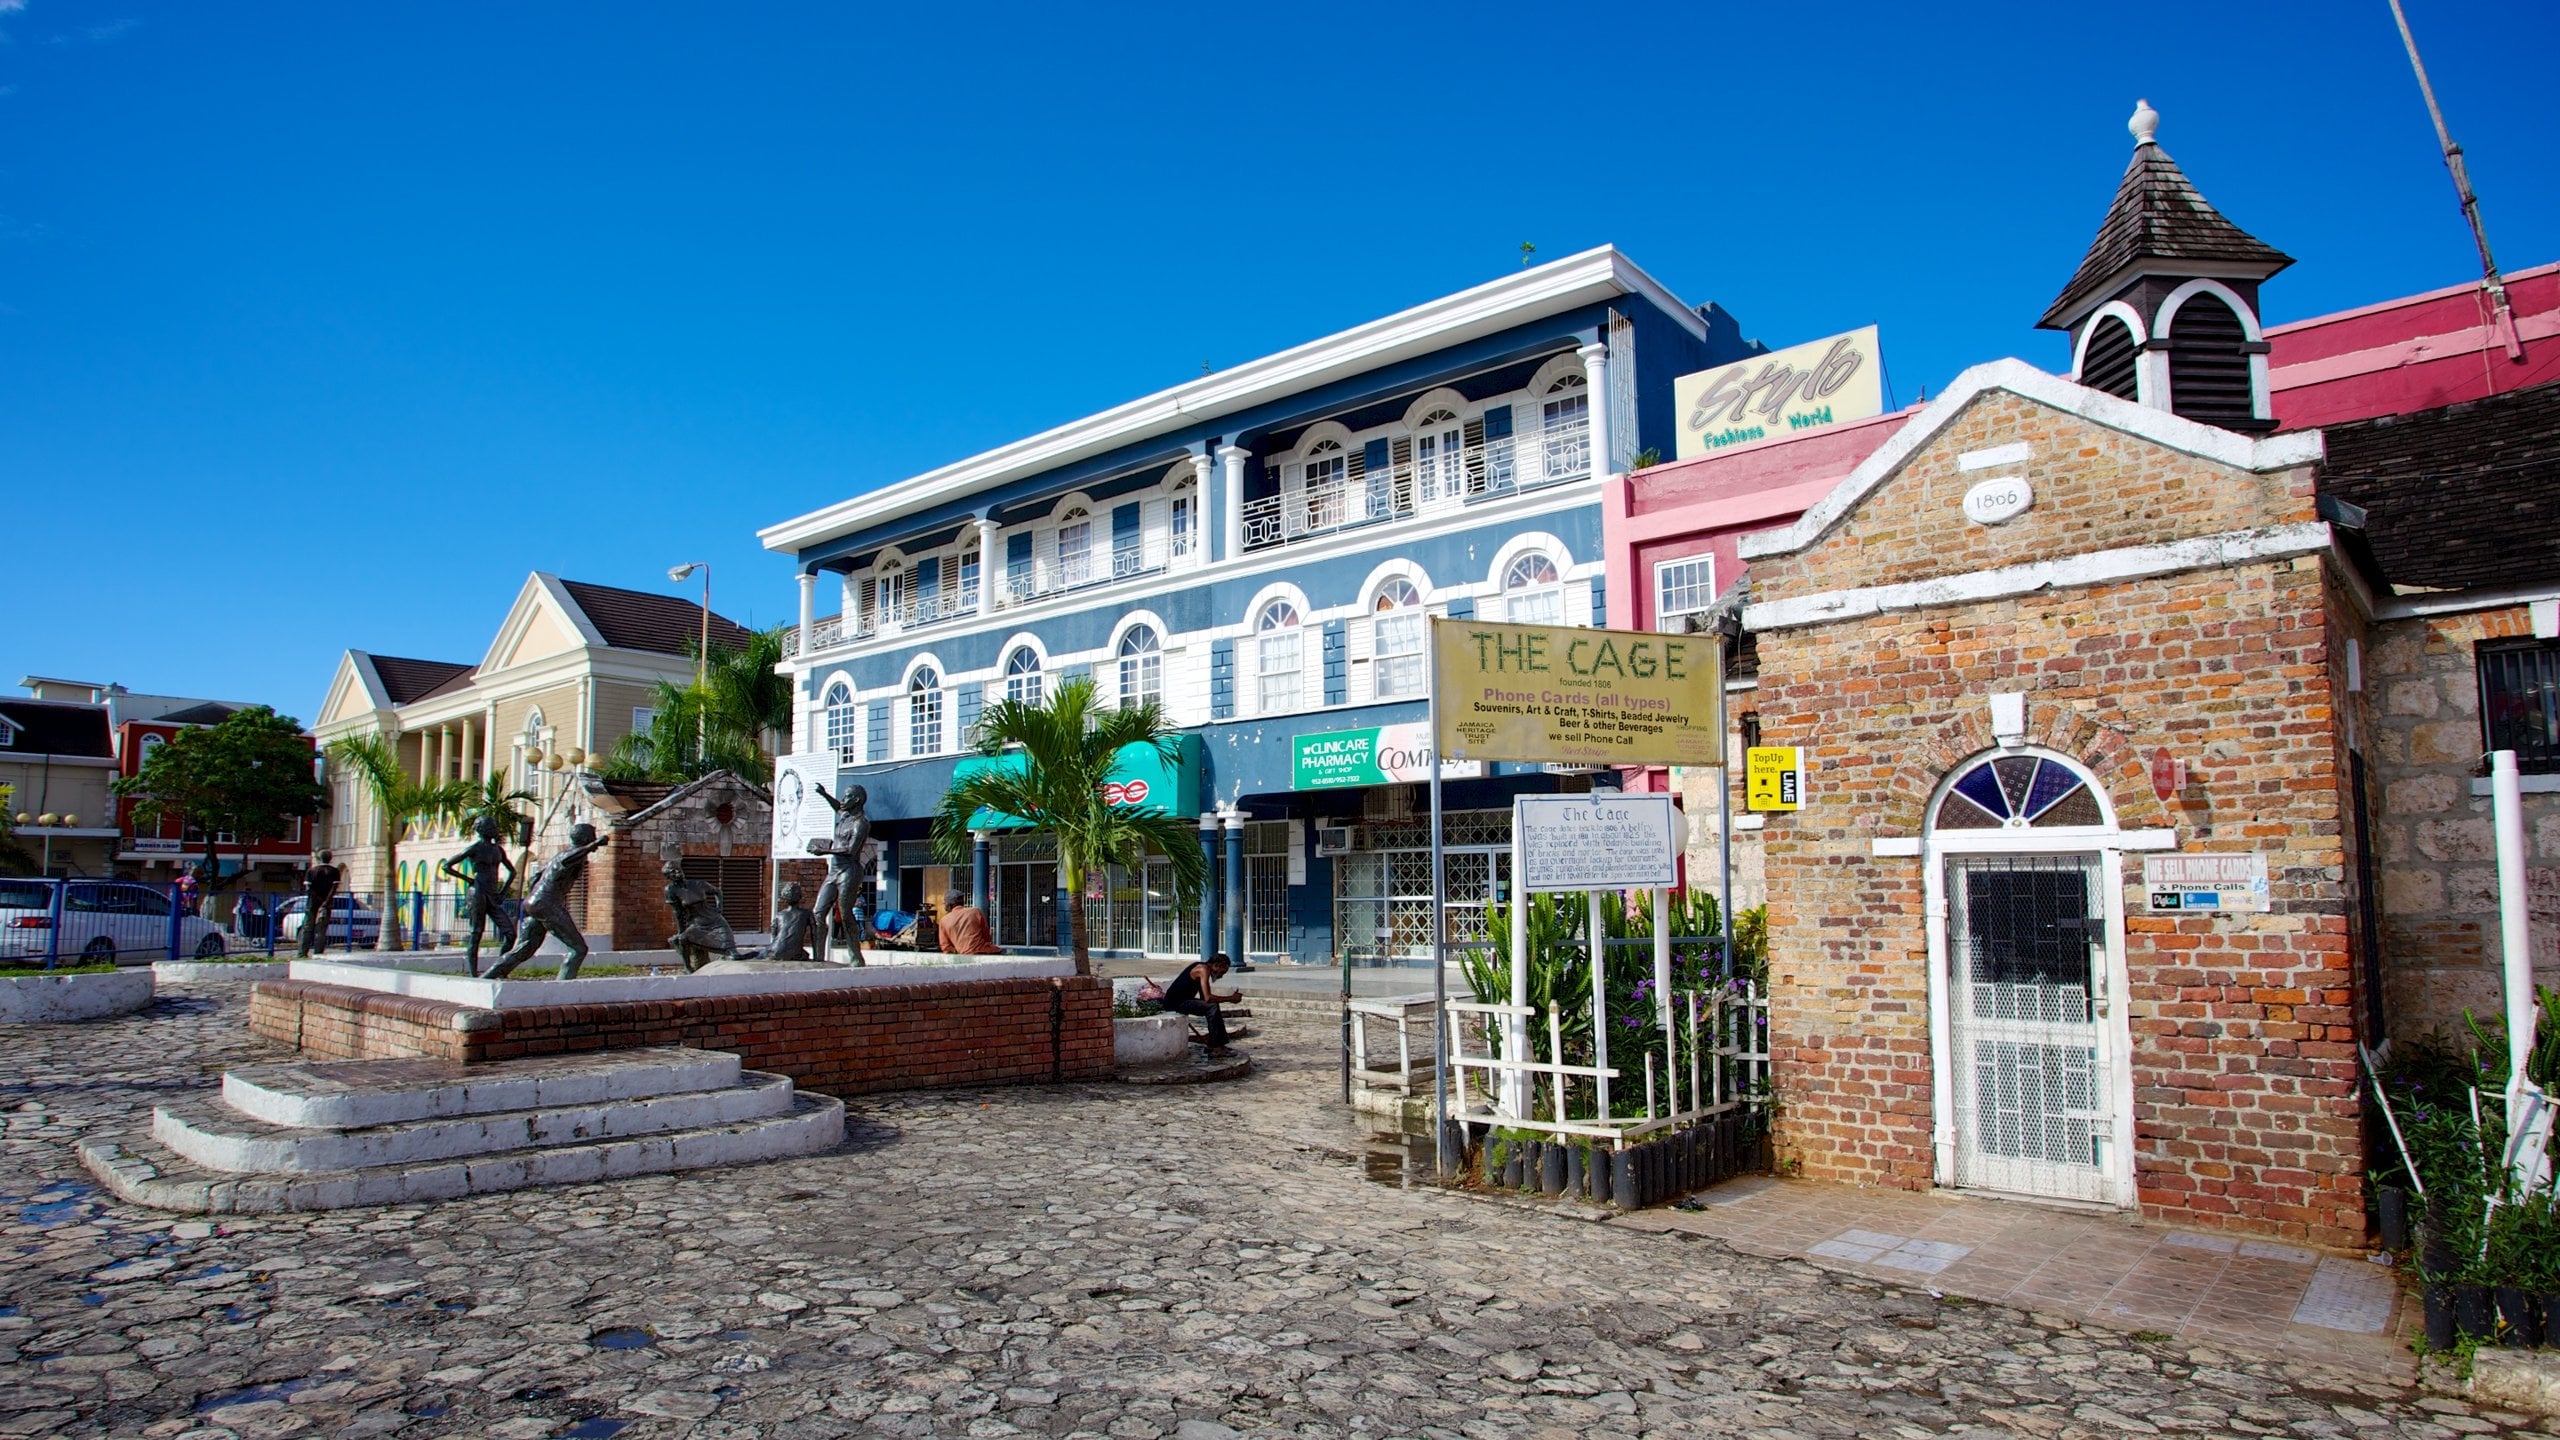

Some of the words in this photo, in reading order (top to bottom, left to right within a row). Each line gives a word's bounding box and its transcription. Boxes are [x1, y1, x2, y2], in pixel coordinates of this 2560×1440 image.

[1690, 337, 1863, 429] Stylo
[1703, 425, 1765, 450] Fashions
[1788, 405, 1833, 430] World
[1976, 490, 2018, 509] 1806
[1469, 630, 1551, 673] THE
[1566, 637, 1688, 682] CAGE
[1560, 678, 1592, 688] founded
[1594, 680, 1612, 689] 1806
[1484, 688, 1536, 703] Phone
[1542, 690, 1590, 706] Cards
[1596, 693, 1619, 708] (all
[1624, 695, 1671, 712] types)
[1474, 702, 1524, 716] Souvenirs,
[1526, 704, 1541, 715] Art
[1544, 706, 1551, 715] &
[1554, 706, 1580, 718] Craft,
[1582, 708, 1619, 720] T-Shirts,
[1621, 710, 1652, 722] Beaded
[1655, 713, 1689, 726] Jewelry
[1560, 718, 1580, 729] Beer
[1584, 720, 1590, 729] &
[1593, 720, 1616, 730] other
[1618, 722, 1664, 735] Beverages
[1310, 738, 1370, 755] CLINICARE
[1564, 732, 1582, 742] sell
[1584, 733, 1614, 744] Phone
[1616, 735, 1634, 744] Call
[1302, 752, 1369, 769] PHARMACY
[1754, 754, 1784, 764] TopUp
[1754, 765, 1778, 774] here.
[1783, 772, 1794, 802] LIME
[1563, 807, 1588, 821] The
[1595, 808, 1629, 823] Cage
[1546, 840, 1578, 851] replaced
[1630, 838, 1662, 847] building
[2149, 858, 2164, 881] WE
[2164, 858, 2184, 881] SELL
[2186, 858, 2220, 881] PHONE
[2220, 858, 2252, 881] CARDS
[2214, 883, 2246, 891] Calls
[2154, 894, 2177, 908] Digicel
